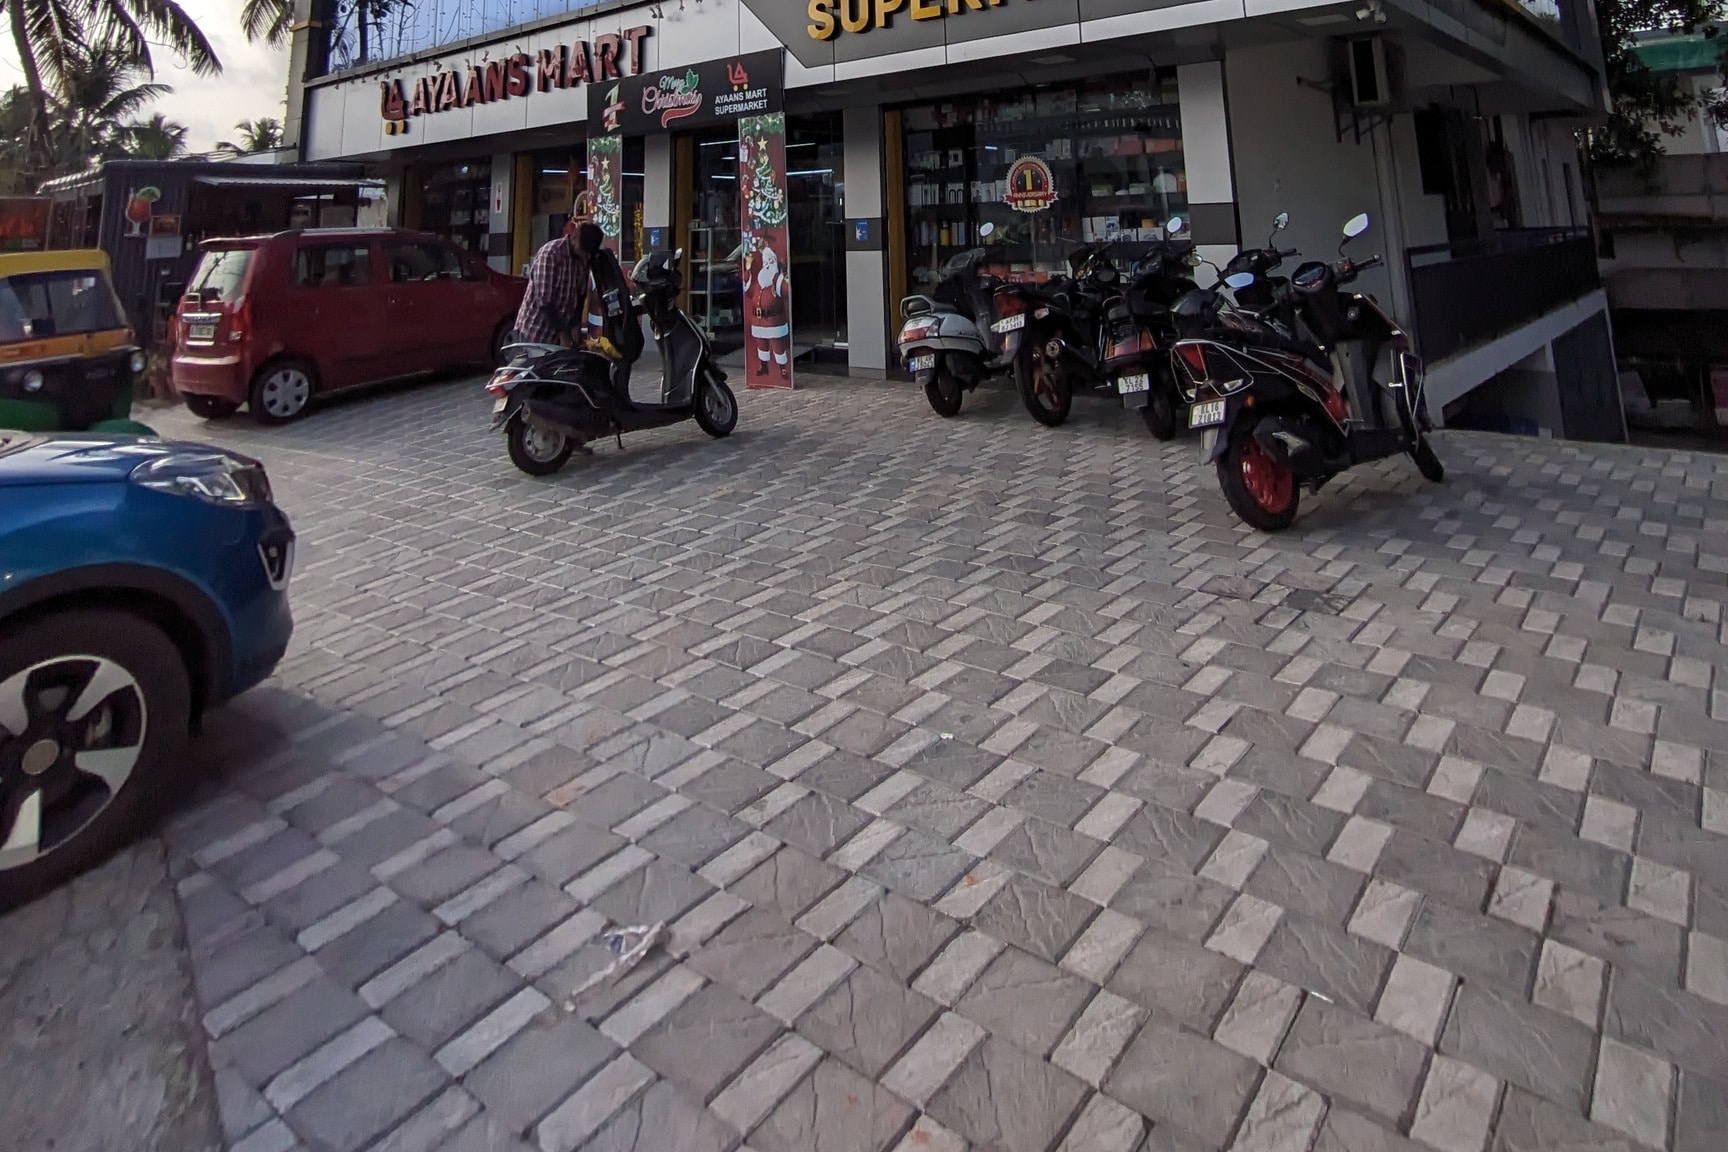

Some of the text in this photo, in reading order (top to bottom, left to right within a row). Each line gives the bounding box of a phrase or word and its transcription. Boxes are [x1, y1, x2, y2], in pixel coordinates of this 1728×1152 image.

[409, 25, 652, 116] AYAANS MART
[642, 86, 703, 115] Christmas
[715, 88, 768, 105] AYAANS MART
[715, 99, 769, 116] SUPERMARKET
[1023, 169, 1033, 190] 1
